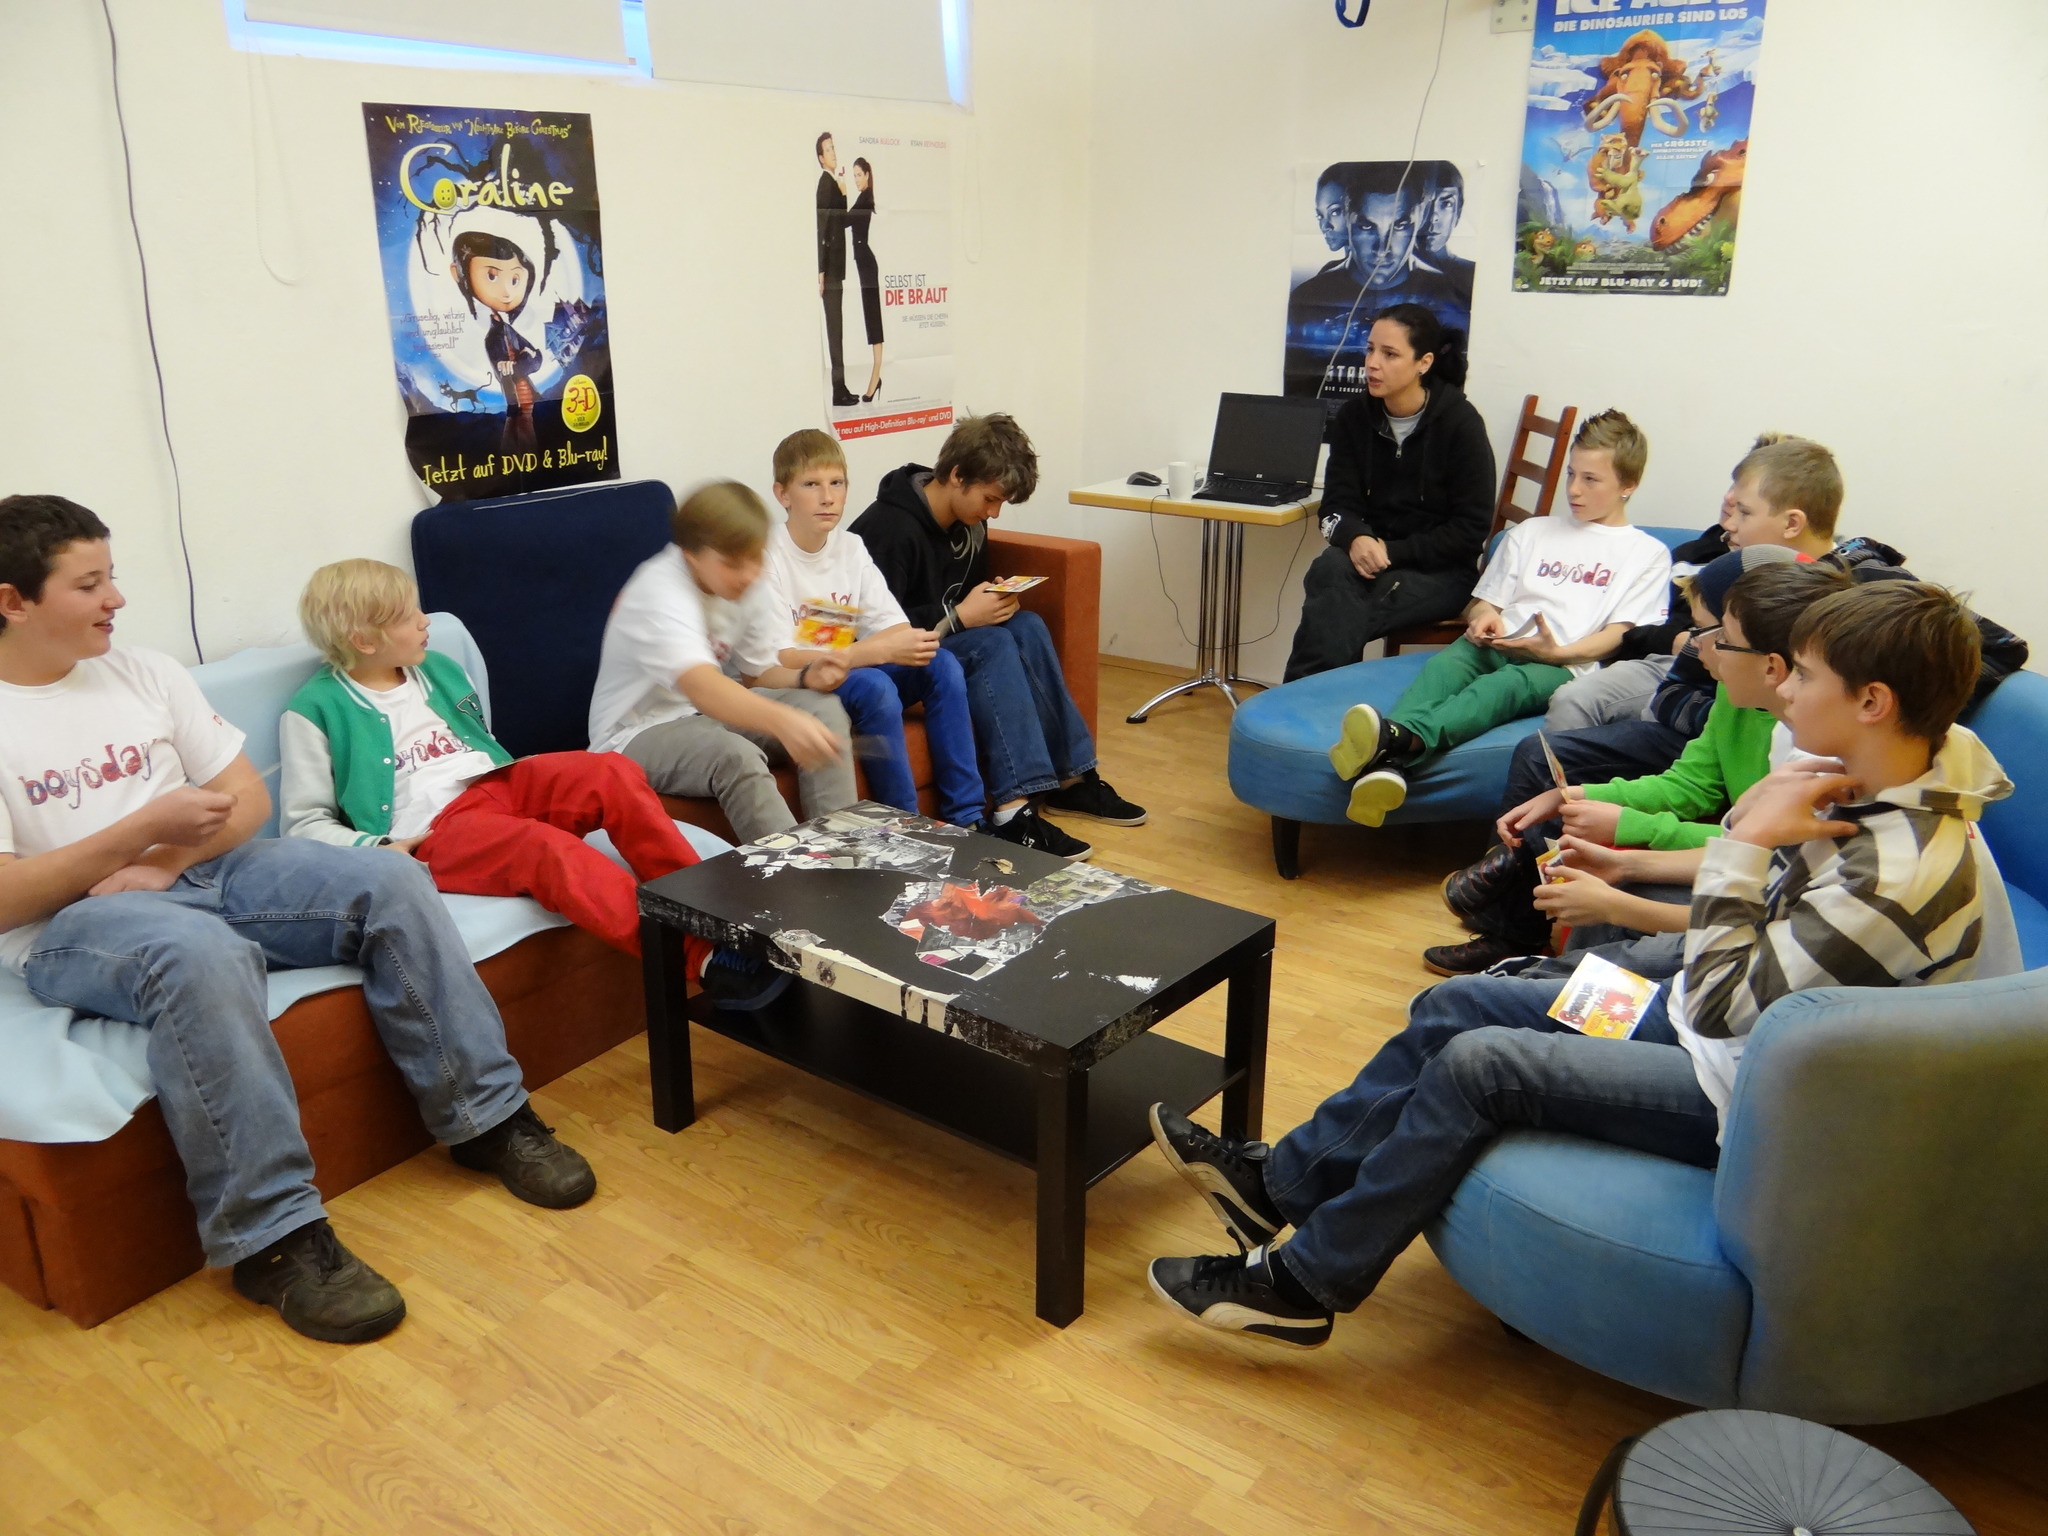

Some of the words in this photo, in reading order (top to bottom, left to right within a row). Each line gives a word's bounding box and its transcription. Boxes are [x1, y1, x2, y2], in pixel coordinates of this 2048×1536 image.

[1554, 20, 1578, 32] DIE
[1580, 13, 1674, 31] DINOSAURIER
[1678, 10, 1716, 23] SIND
[1719, 8, 1749, 20] LOS
[1664, 138, 1708, 148] GRÖSSTE
[400, 143, 574, 216] Coraline
[885, 274, 912, 288] SELBST
[915, 274, 926, 287] IST
[1539, 277, 1573, 286] JETZT
[1575, 278, 1599, 287] AUF
[1658, 279, 1670, 288] &
[1672, 279, 1703, 288] DVD!
[885, 289, 904, 306] DIE
[908, 287, 948, 305] BRAUT
[1325, 365, 1366, 384] STAR
[566, 386, 597, 413] 3-D
[841, 427, 853, 435] neu
[854, 424, 864, 433] auf
[865, 418, 907, 433] High-Definition
[928, 413, 939, 422] und
[940, 411, 952, 420] DVD
[421, 454, 467, 487] Jetzt
[473, 454, 495, 479] auf
[502, 453, 538, 476] DVD
[543, 450, 553, 469] &
[559, 436, 608, 470] Blu-ray!
